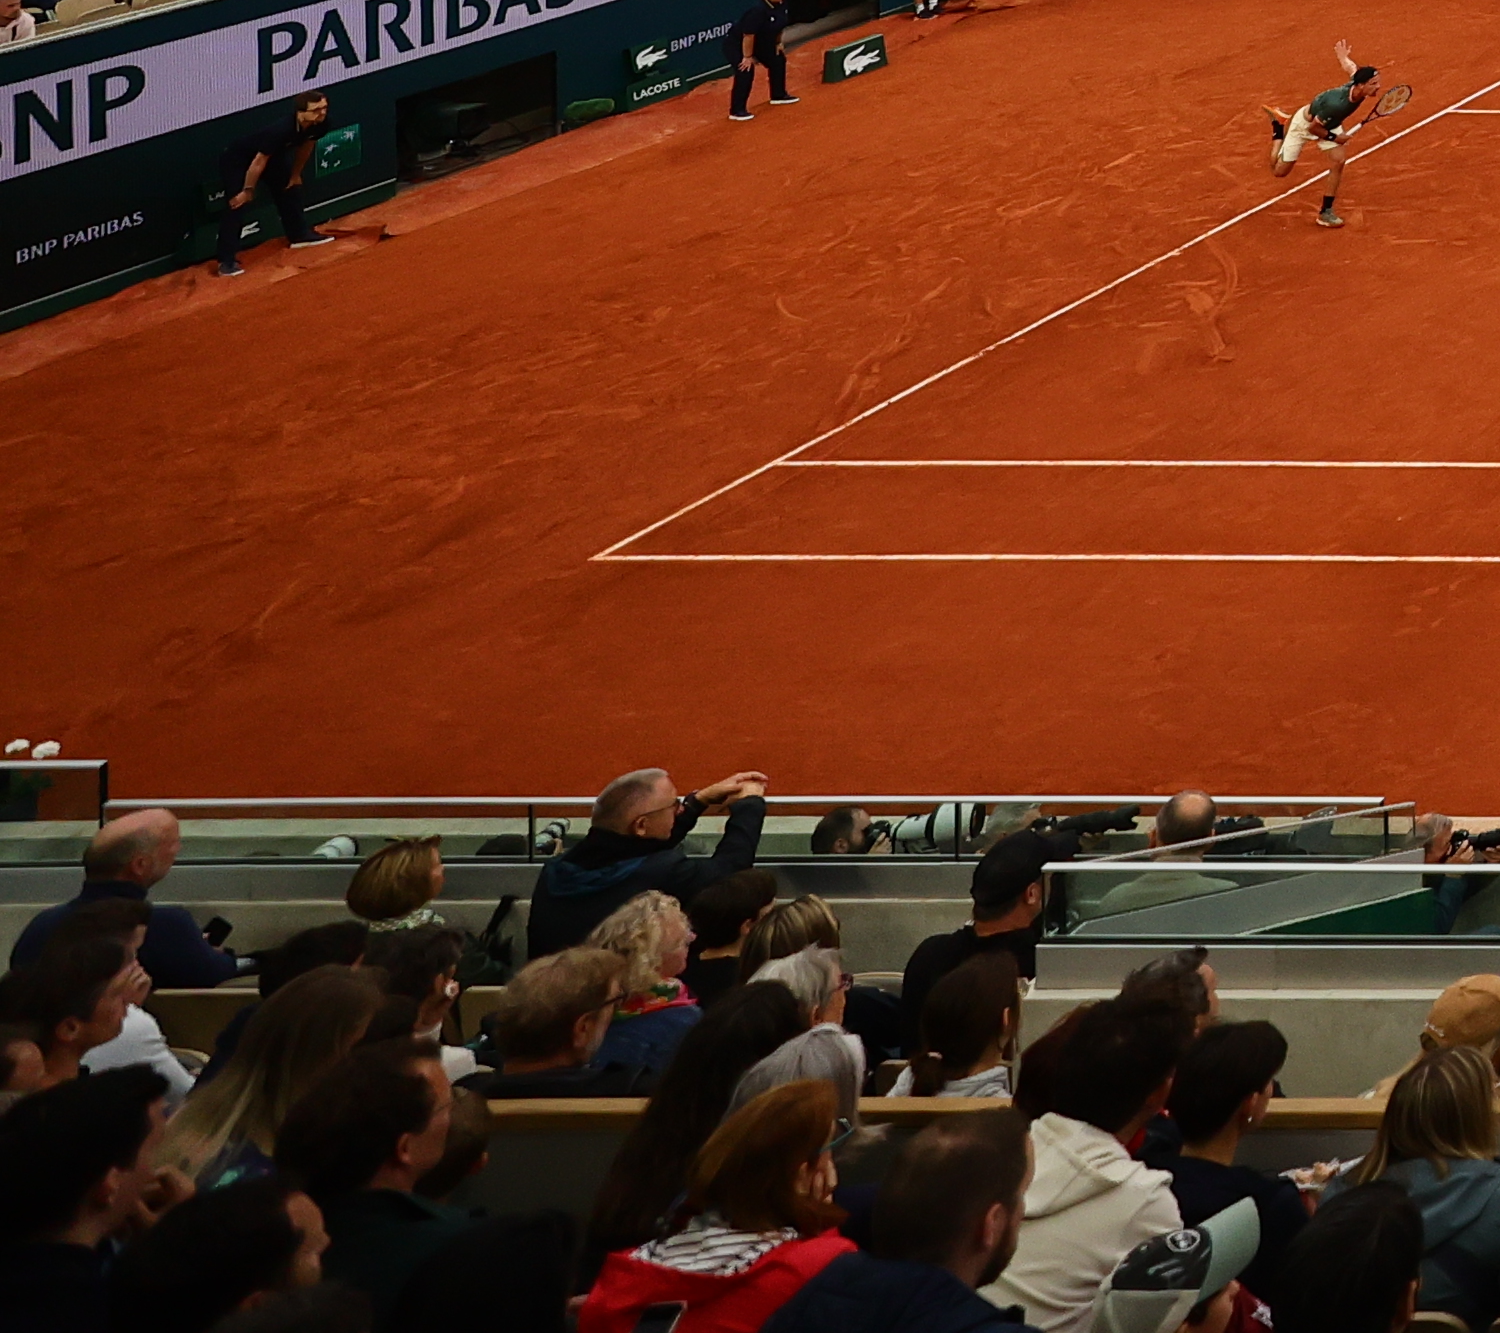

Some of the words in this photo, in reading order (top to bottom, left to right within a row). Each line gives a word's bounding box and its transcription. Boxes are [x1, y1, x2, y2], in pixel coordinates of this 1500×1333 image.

[670, 33, 697, 52] BNP
[632, 76, 682, 101] LACOSTE
[0, 64, 146, 166] NP
[15, 237, 58, 266] BNP
[62, 210, 145, 252] PARIBAS
